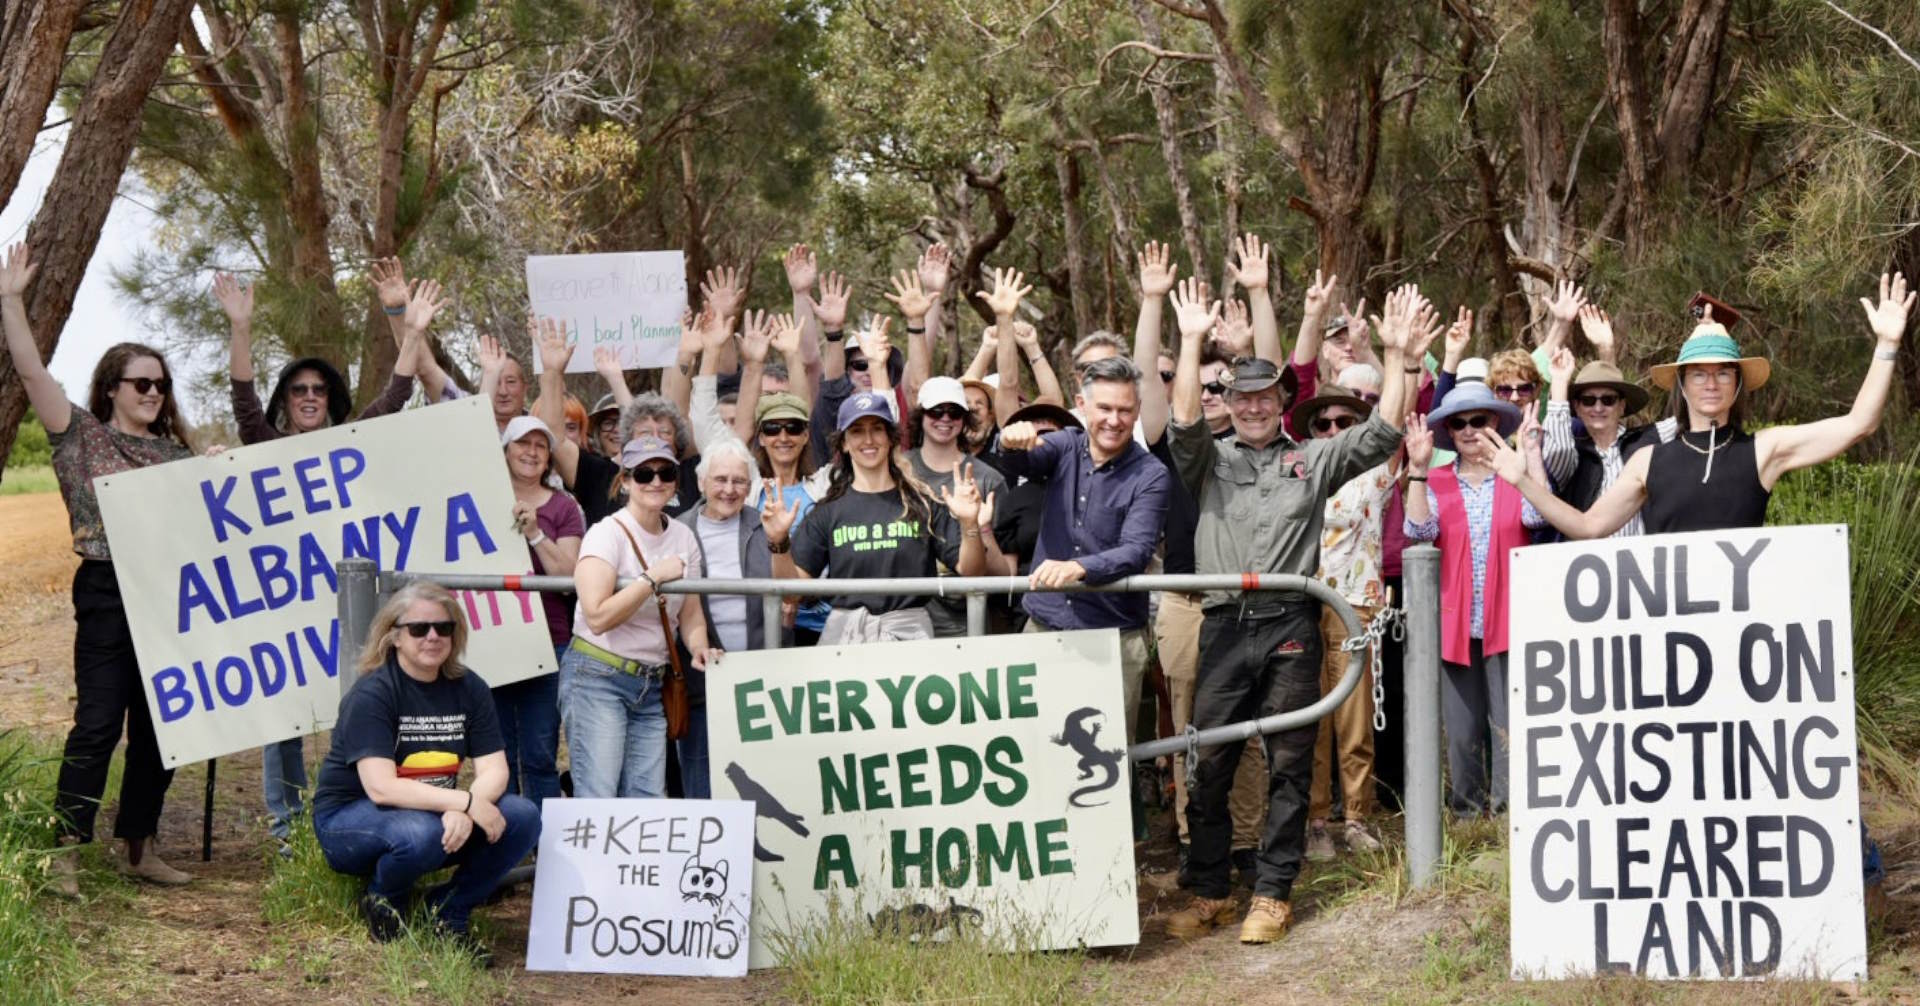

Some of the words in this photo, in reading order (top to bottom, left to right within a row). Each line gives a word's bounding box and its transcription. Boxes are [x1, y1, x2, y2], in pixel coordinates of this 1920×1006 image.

[594, 313, 623, 343] bad
[200, 447, 366, 542] KEEP
[178, 506, 421, 633] ALBANY
[445, 492, 498, 562] A
[833, 525, 868, 547] give
[872, 524, 883, 539] a
[1564, 538, 1771, 623] ONLY
[151, 569, 537, 723] BIODIVITY
[1525, 632, 1713, 716] BUILD
[1739, 619, 1836, 702] ON
[734, 663, 1038, 742] EVERYONE
[818, 736, 1029, 815] NEEDS
[1526, 716, 1851, 809] EXISTING
[563, 816, 724, 868] #KEEP
[618, 864, 660, 887] THE
[813, 834, 859, 890] A
[890, 818, 1074, 890] HOME
[1530, 815, 1834, 903] CLEARED
[1594, 900, 1783, 977] LAND
